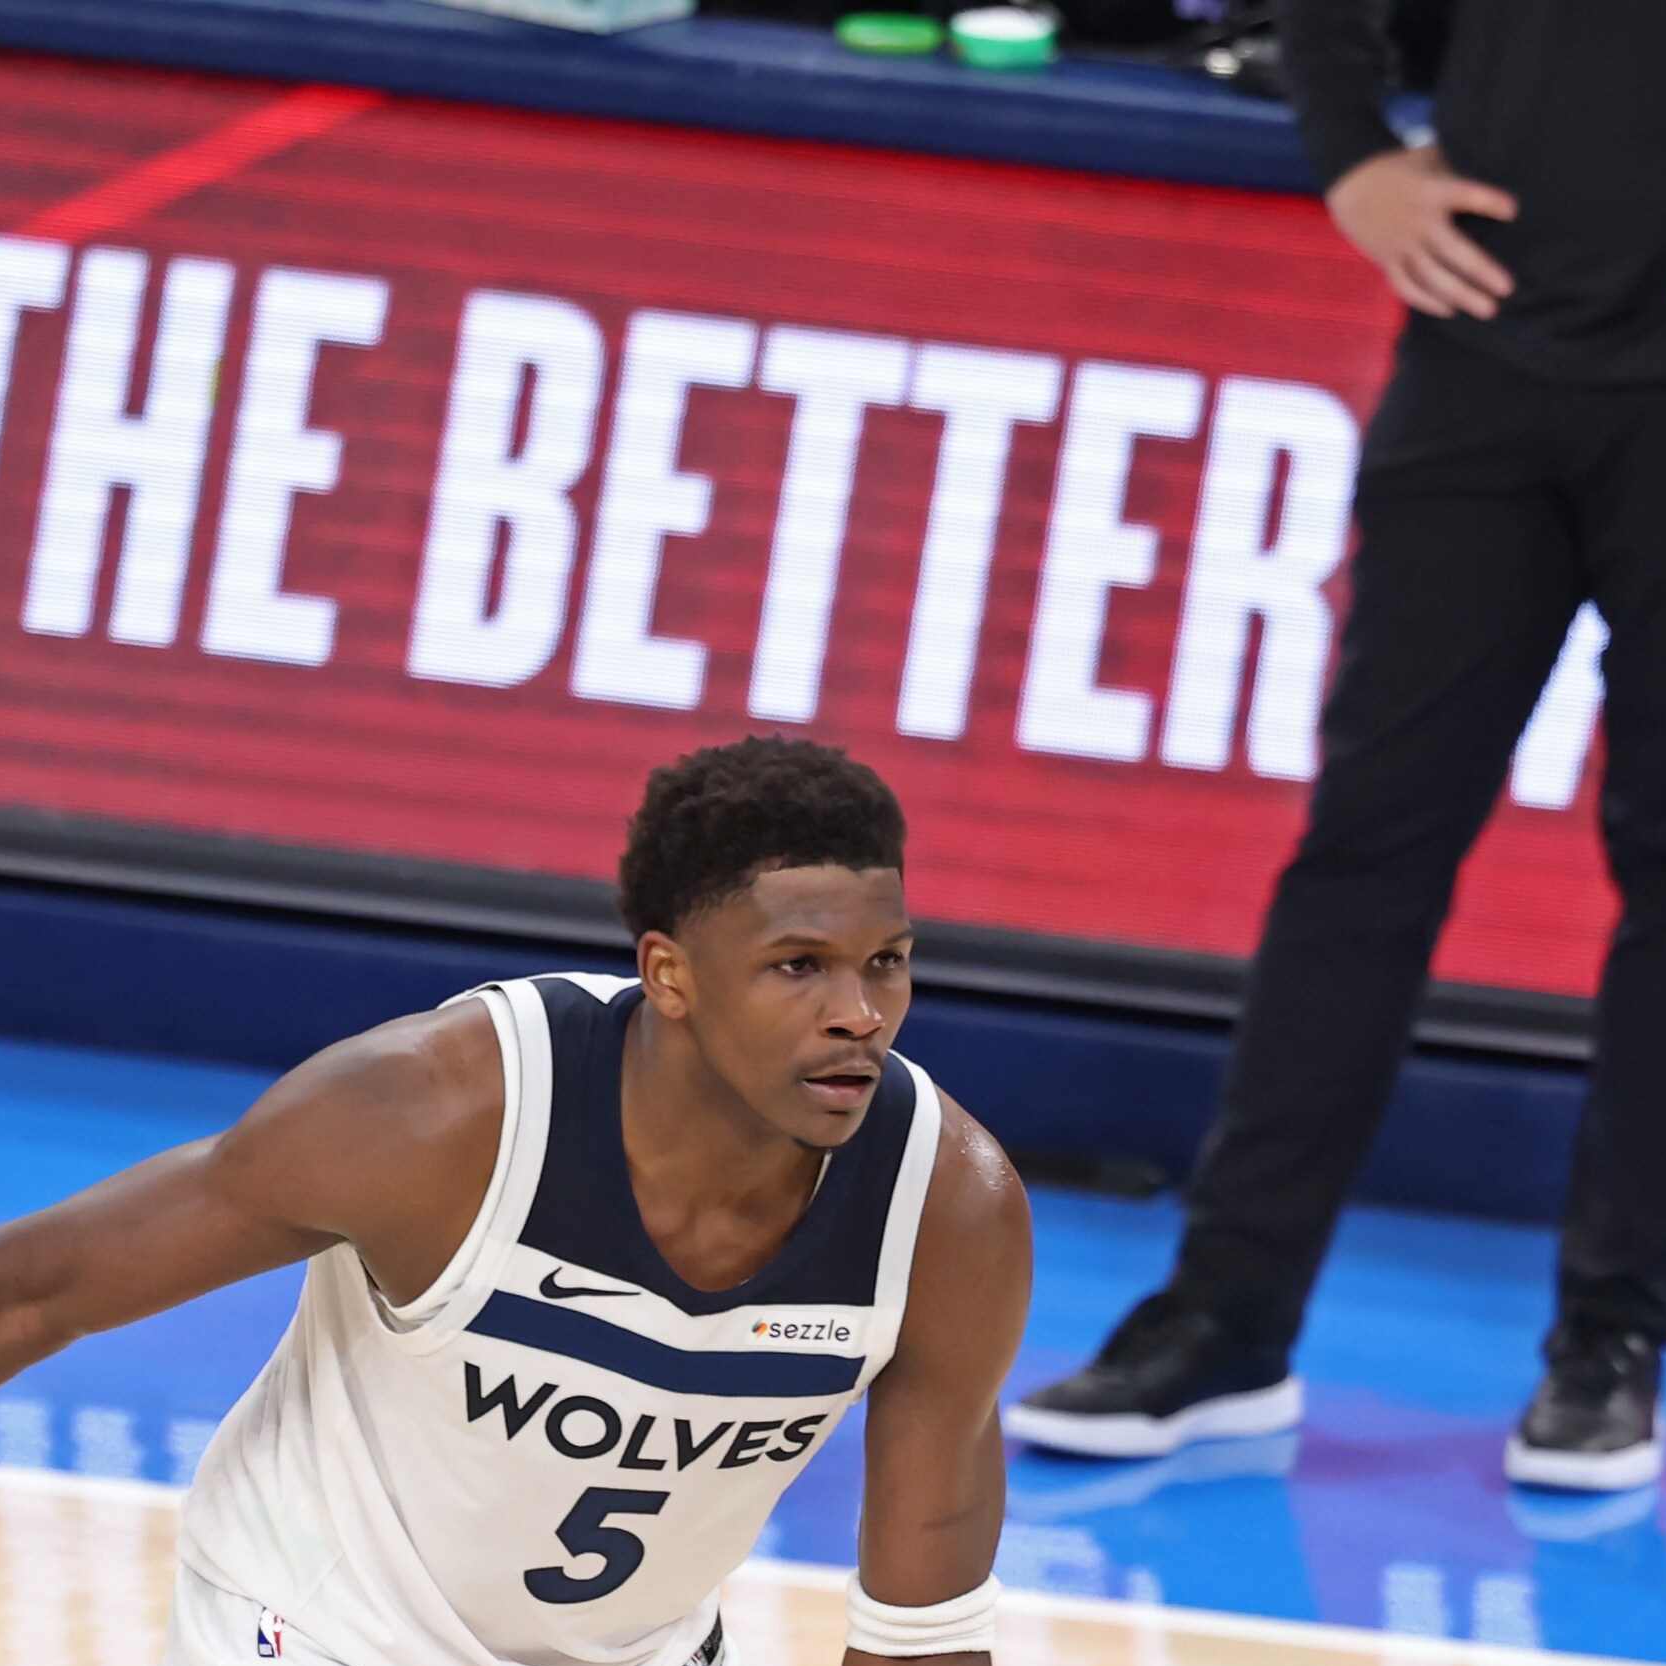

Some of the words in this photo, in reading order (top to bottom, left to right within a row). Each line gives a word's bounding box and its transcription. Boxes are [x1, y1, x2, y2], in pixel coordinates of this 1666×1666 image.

[406, 288, 1361, 782] BETTER
[769, 1318, 851, 1342] sezzle
[463, 1361, 829, 1472] WOLVES
[523, 1486, 671, 1605] 5
